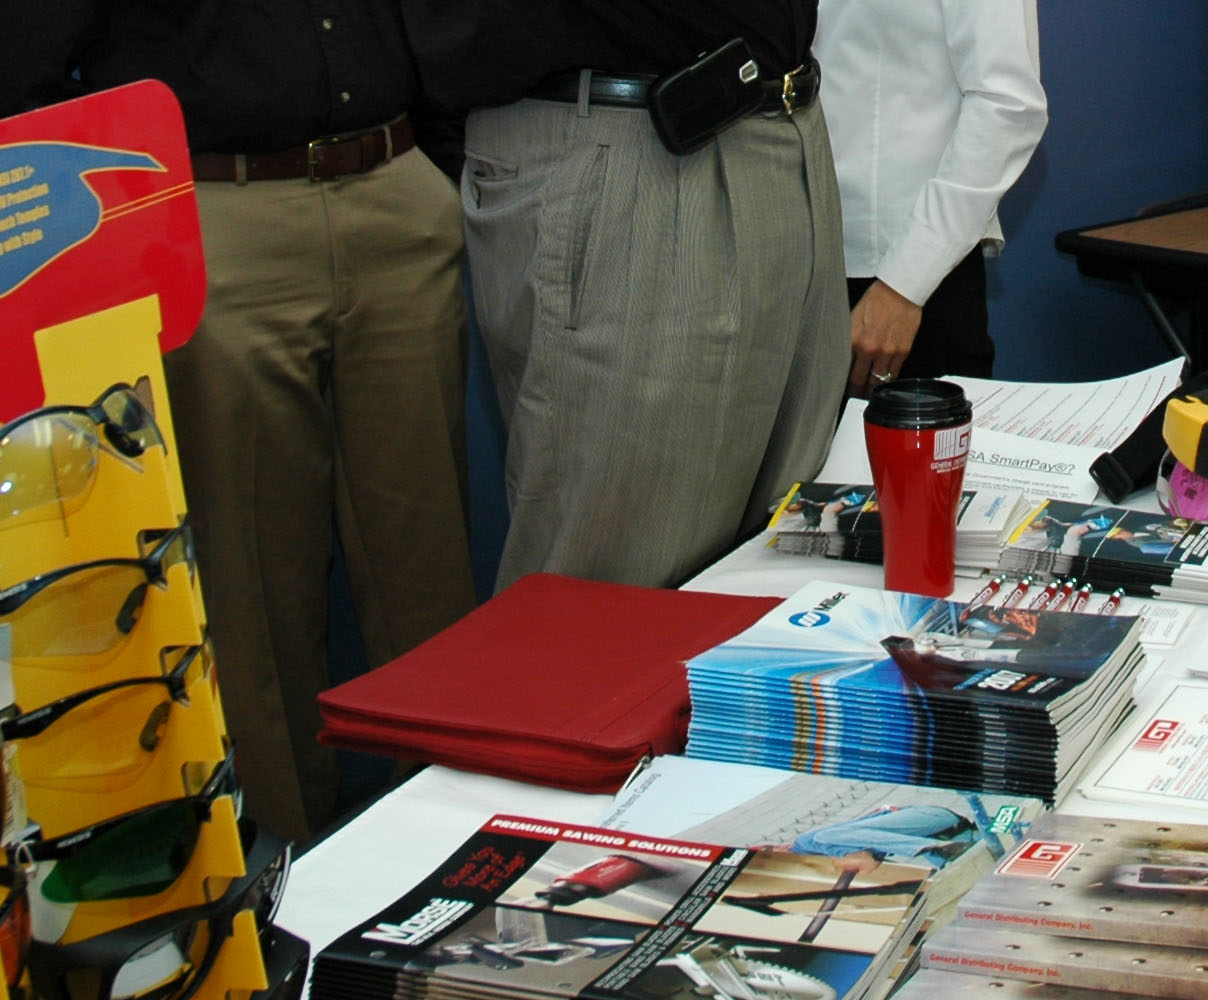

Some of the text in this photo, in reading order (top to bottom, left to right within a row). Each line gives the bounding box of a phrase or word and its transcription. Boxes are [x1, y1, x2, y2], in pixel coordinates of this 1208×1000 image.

[967, 450, 986, 463] SA
[490, 819, 712, 859] PREMIUM SAWING SOLUTIONS
[964, 911, 994, 921] General
[995, 912, 1038, 927] Distributing
[1079, 921, 1094, 931] Inc.
[929, 953, 960, 965] General
[961, 956, 1005, 971] Distributing
[1046, 967, 1062, 978] Inc.
